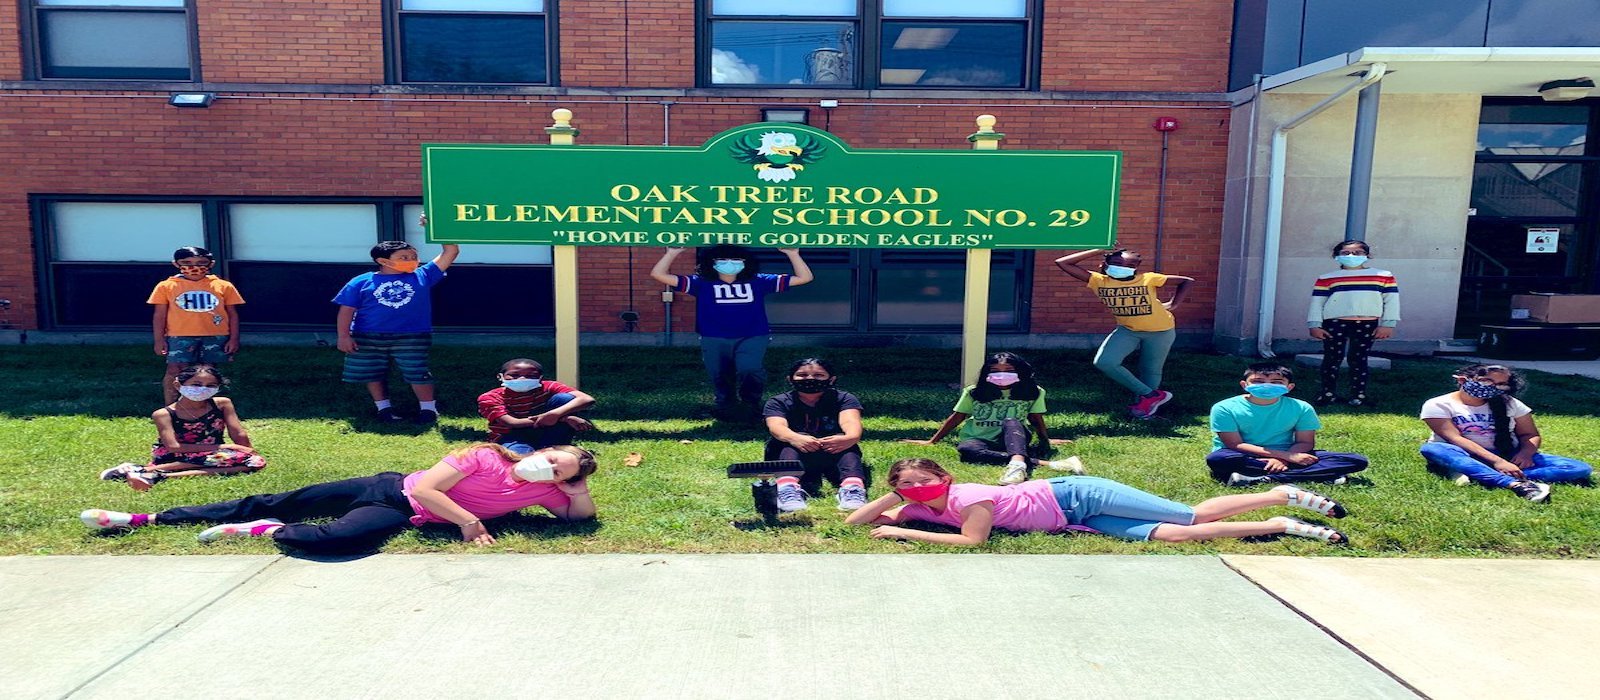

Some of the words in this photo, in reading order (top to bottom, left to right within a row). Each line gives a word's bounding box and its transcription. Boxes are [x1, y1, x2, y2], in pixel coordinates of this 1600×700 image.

[610, 184, 699, 202] OAK
[710, 186, 813, 203] TREE
[827, 187, 938, 204] ROAD
[454, 204, 760, 225] ELEMENTARY
[773, 208, 952, 226] SCHOOL
[964, 210, 1036, 226] NO.
[1049, 210, 1090, 227] 29
[553, 231, 648, 243] "HOME
[656, 231, 692, 243] OF
[699, 233, 752, 244] THE
[760, 233, 869, 245] GOLDEN
[878, 234, 992, 246] EAGLES"
[1099, 286, 1148, 296] STRAIGHT
[183, 293, 212, 309] HI!
[1112, 305, 1152, 315] RANTINE
